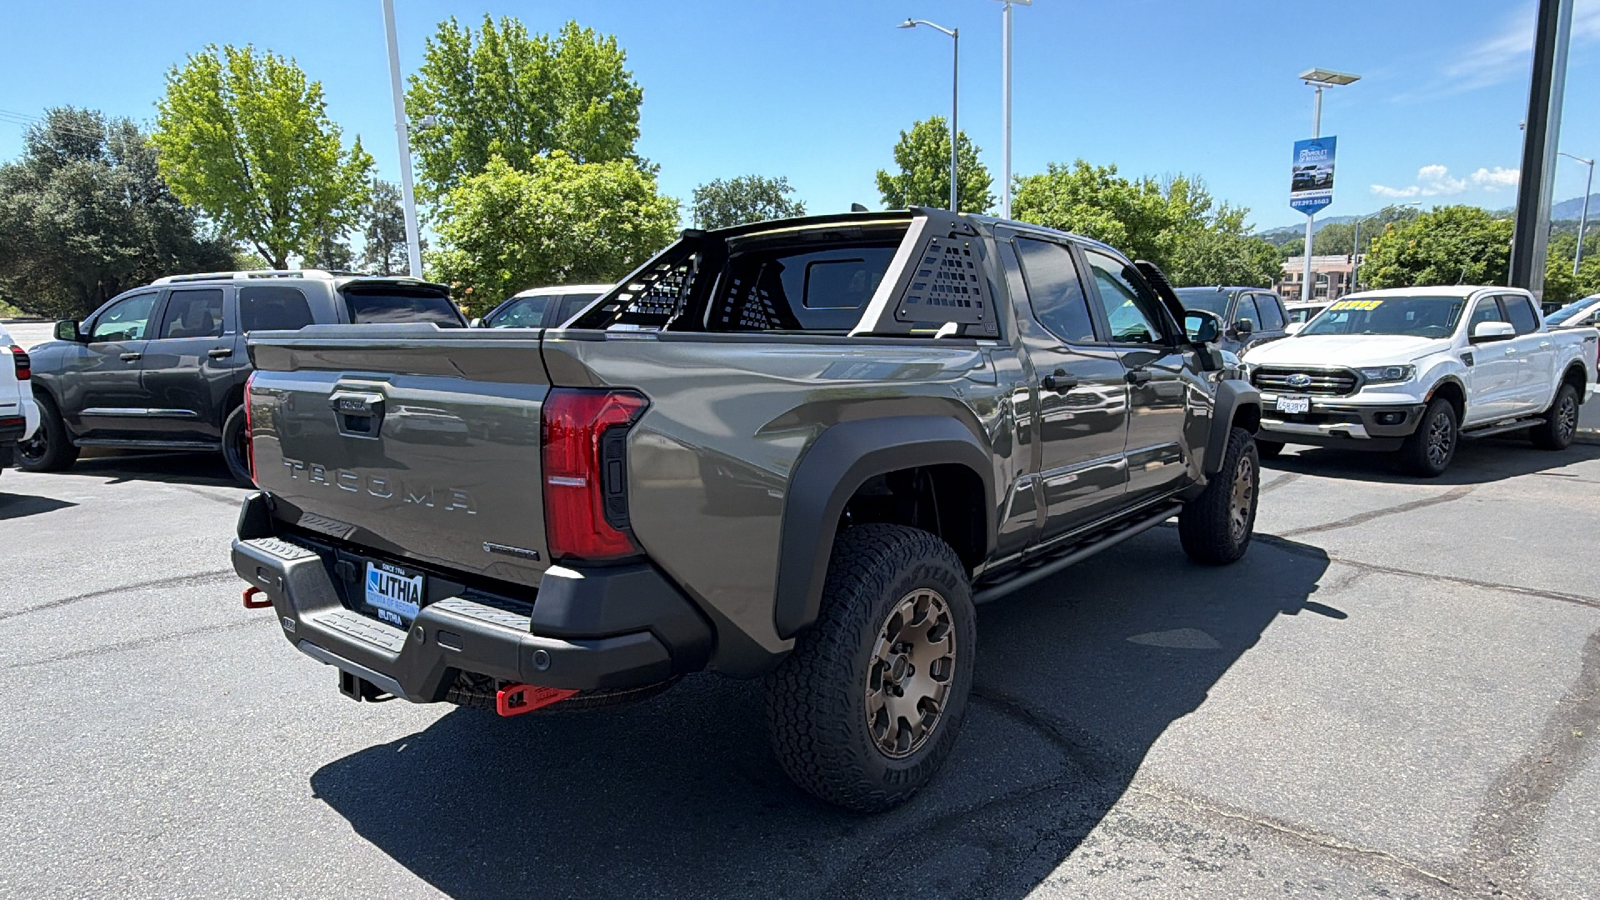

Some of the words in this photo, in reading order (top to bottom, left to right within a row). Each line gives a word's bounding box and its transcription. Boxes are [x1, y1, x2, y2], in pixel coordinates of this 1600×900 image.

[281, 457, 477, 515] TACOMA
[382, 563, 395, 572] SINCE
[379, 573, 419, 606] LITHIA
